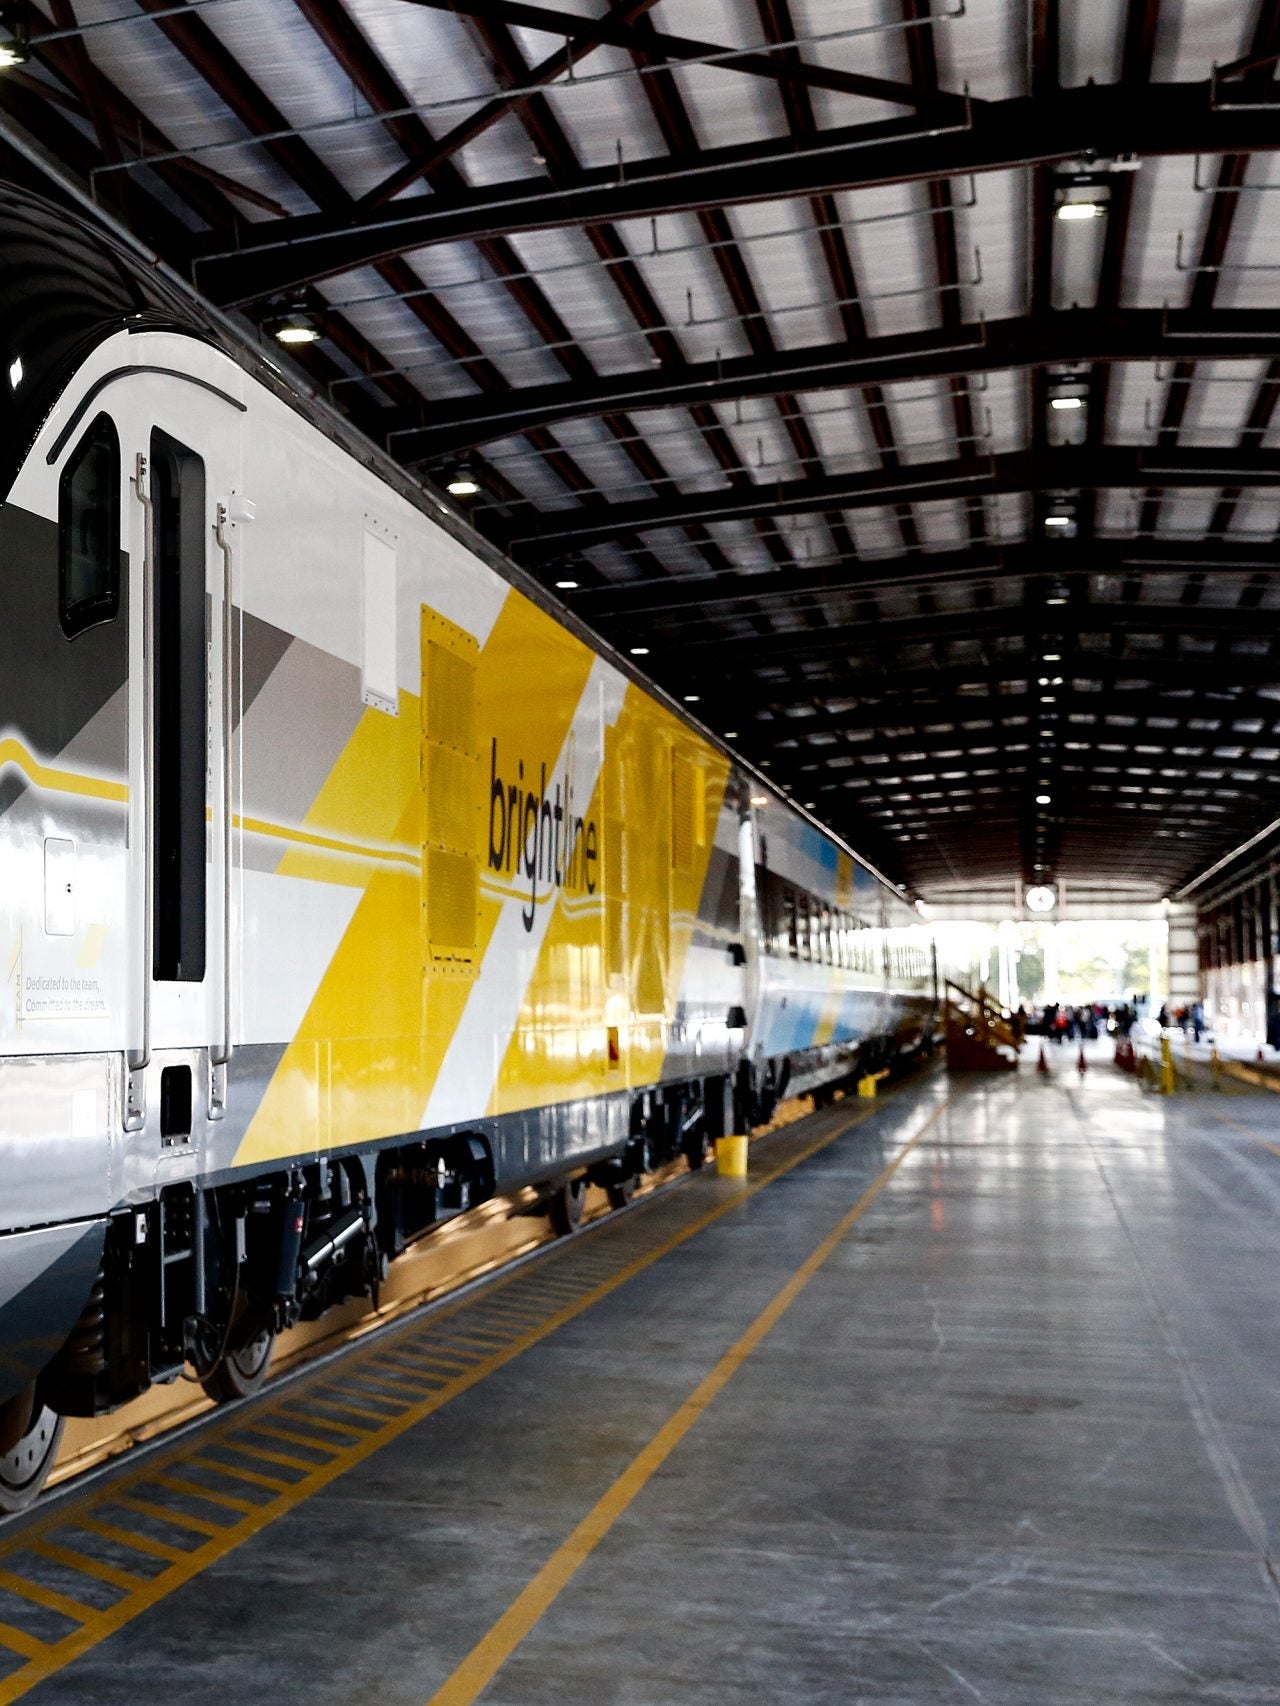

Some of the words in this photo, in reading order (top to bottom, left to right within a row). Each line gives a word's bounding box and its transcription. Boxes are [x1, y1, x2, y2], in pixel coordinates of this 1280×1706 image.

[488, 736, 597, 933] brightline
[25, 976, 61, 991] Dedicated
[62, 977, 69, 990] to
[70, 976, 81, 990] the
